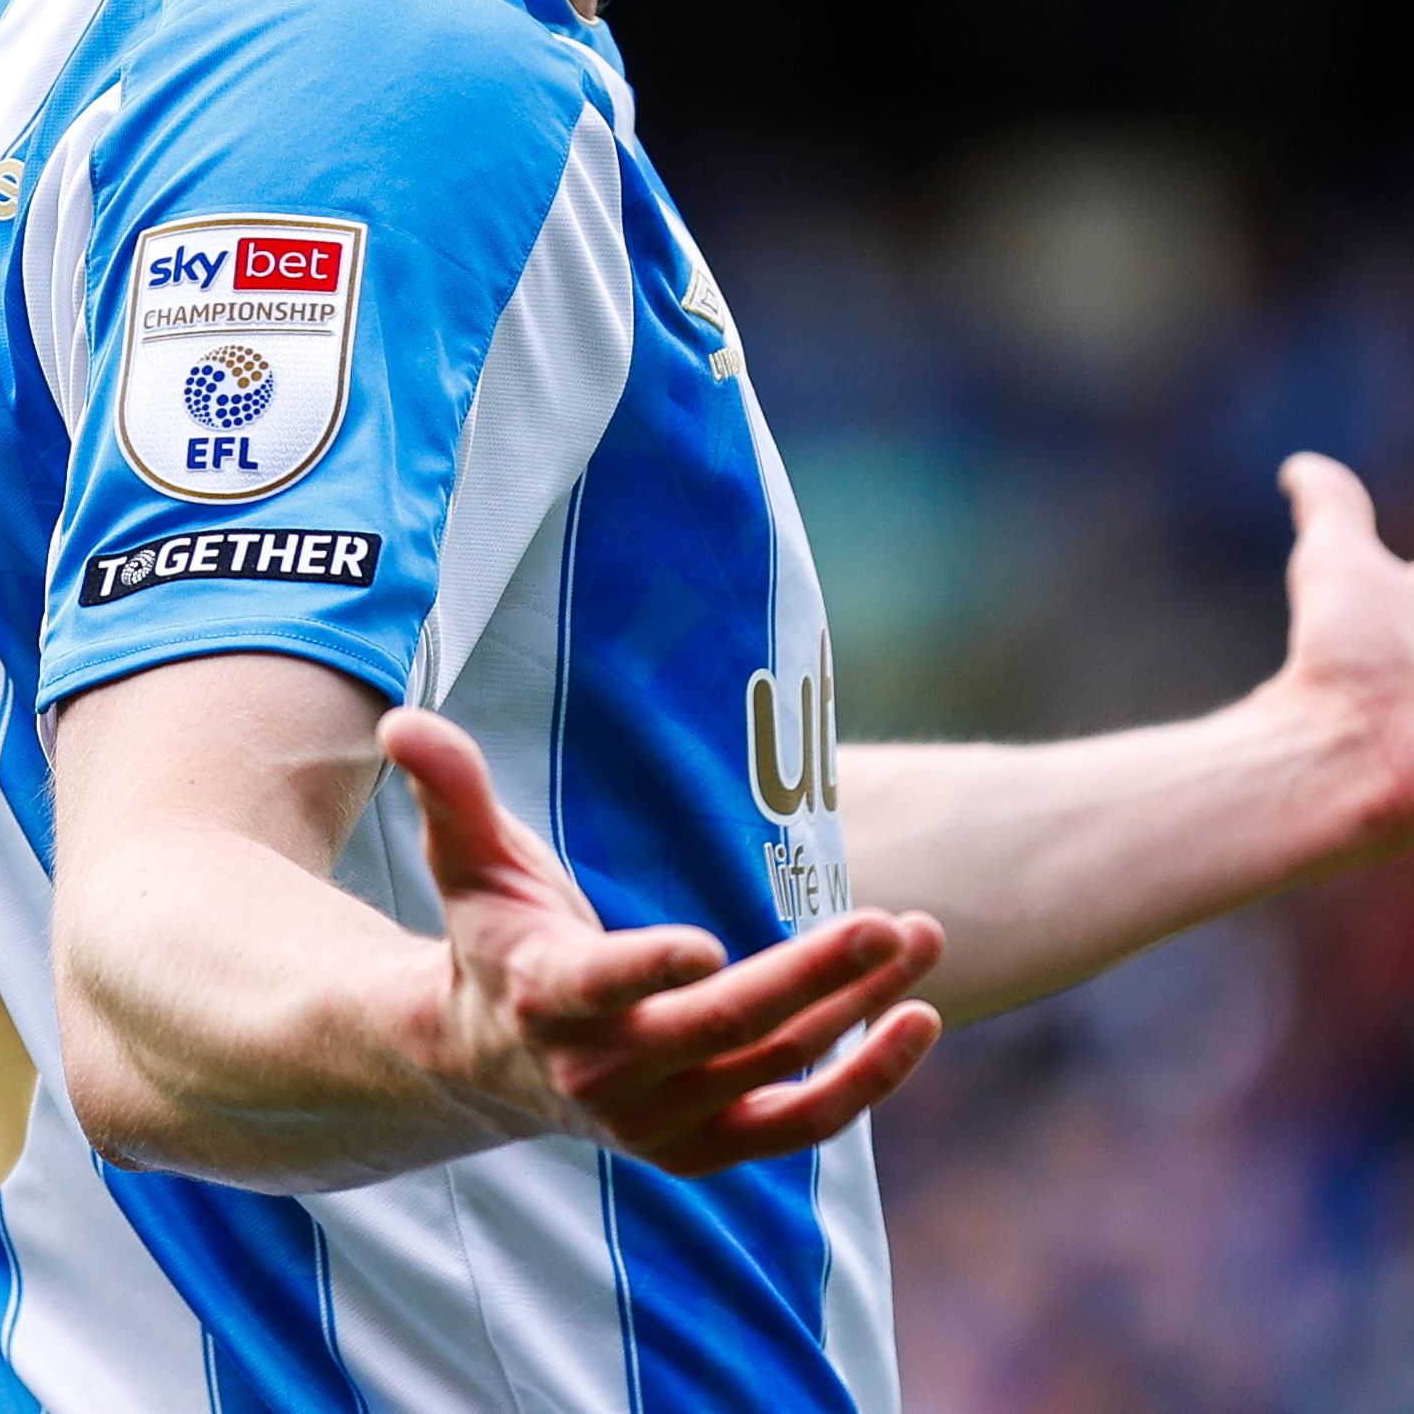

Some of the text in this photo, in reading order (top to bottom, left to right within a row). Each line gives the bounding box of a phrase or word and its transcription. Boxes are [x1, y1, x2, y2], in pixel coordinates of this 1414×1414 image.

[149, 242, 330, 289] sky bet
[143, 300, 335, 330] CHAMPIONSHIP
[186, 436, 259, 471] EFL
[97, 532, 369, 597] TOGETHER
[764, 842, 820, 920] life
